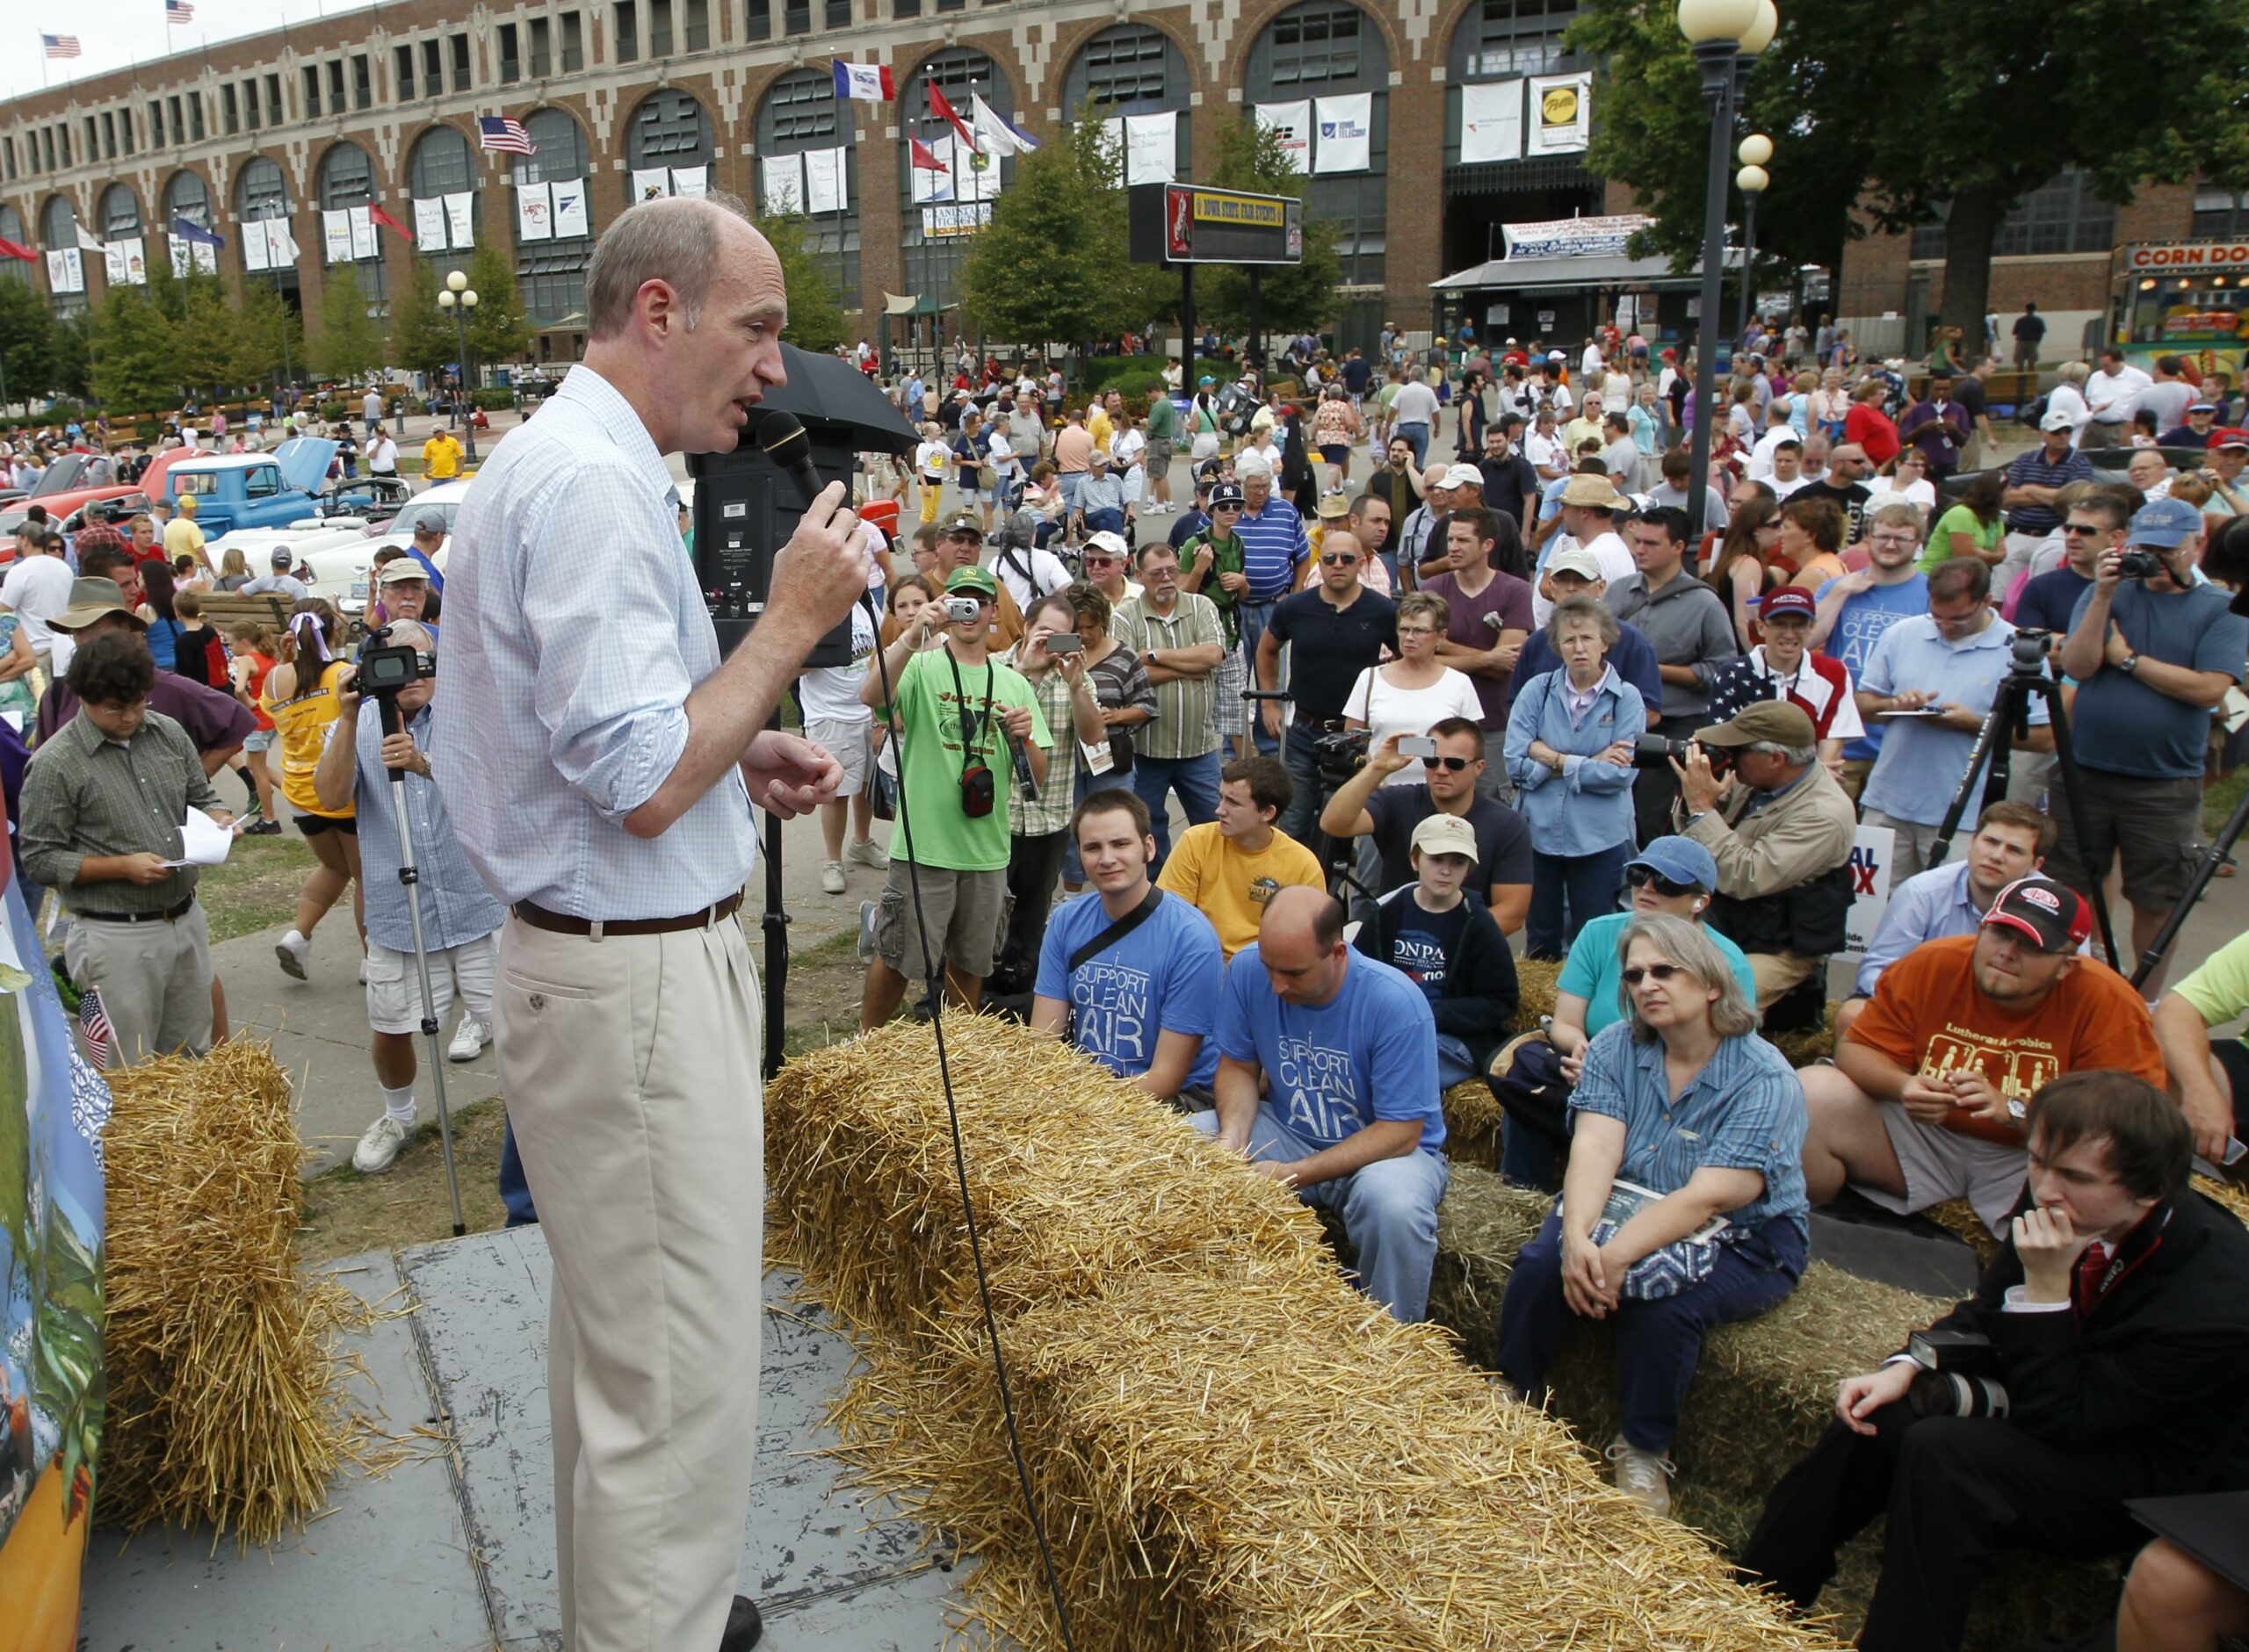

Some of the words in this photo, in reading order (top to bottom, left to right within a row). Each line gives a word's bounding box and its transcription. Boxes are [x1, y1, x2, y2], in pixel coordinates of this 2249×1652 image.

[924, 204, 991, 219] GANDSTAD
[2134, 249, 2203, 265] CORN
[2211, 246, 2249, 263] DO
[1848, 610, 1904, 626] SUPPO
[1842, 622, 1882, 641] CLE
[1841, 638, 1874, 668] AI
[1848, 847, 1879, 869] AL
[1393, 939, 1421, 957] ON
[1845, 943, 1869, 953] entr
[1847, 933, 1862, 942] ide
[1075, 965, 1149, 994] SUPPORT
[1074, 984, 1146, 1019] CLEAN
[1079, 1007, 1144, 1057] AIR
[1279, 1041, 1350, 1076] SUPPORT
[1280, 1061, 1356, 1100] CLEAN
[1287, 1088, 1366, 1138] AIR
